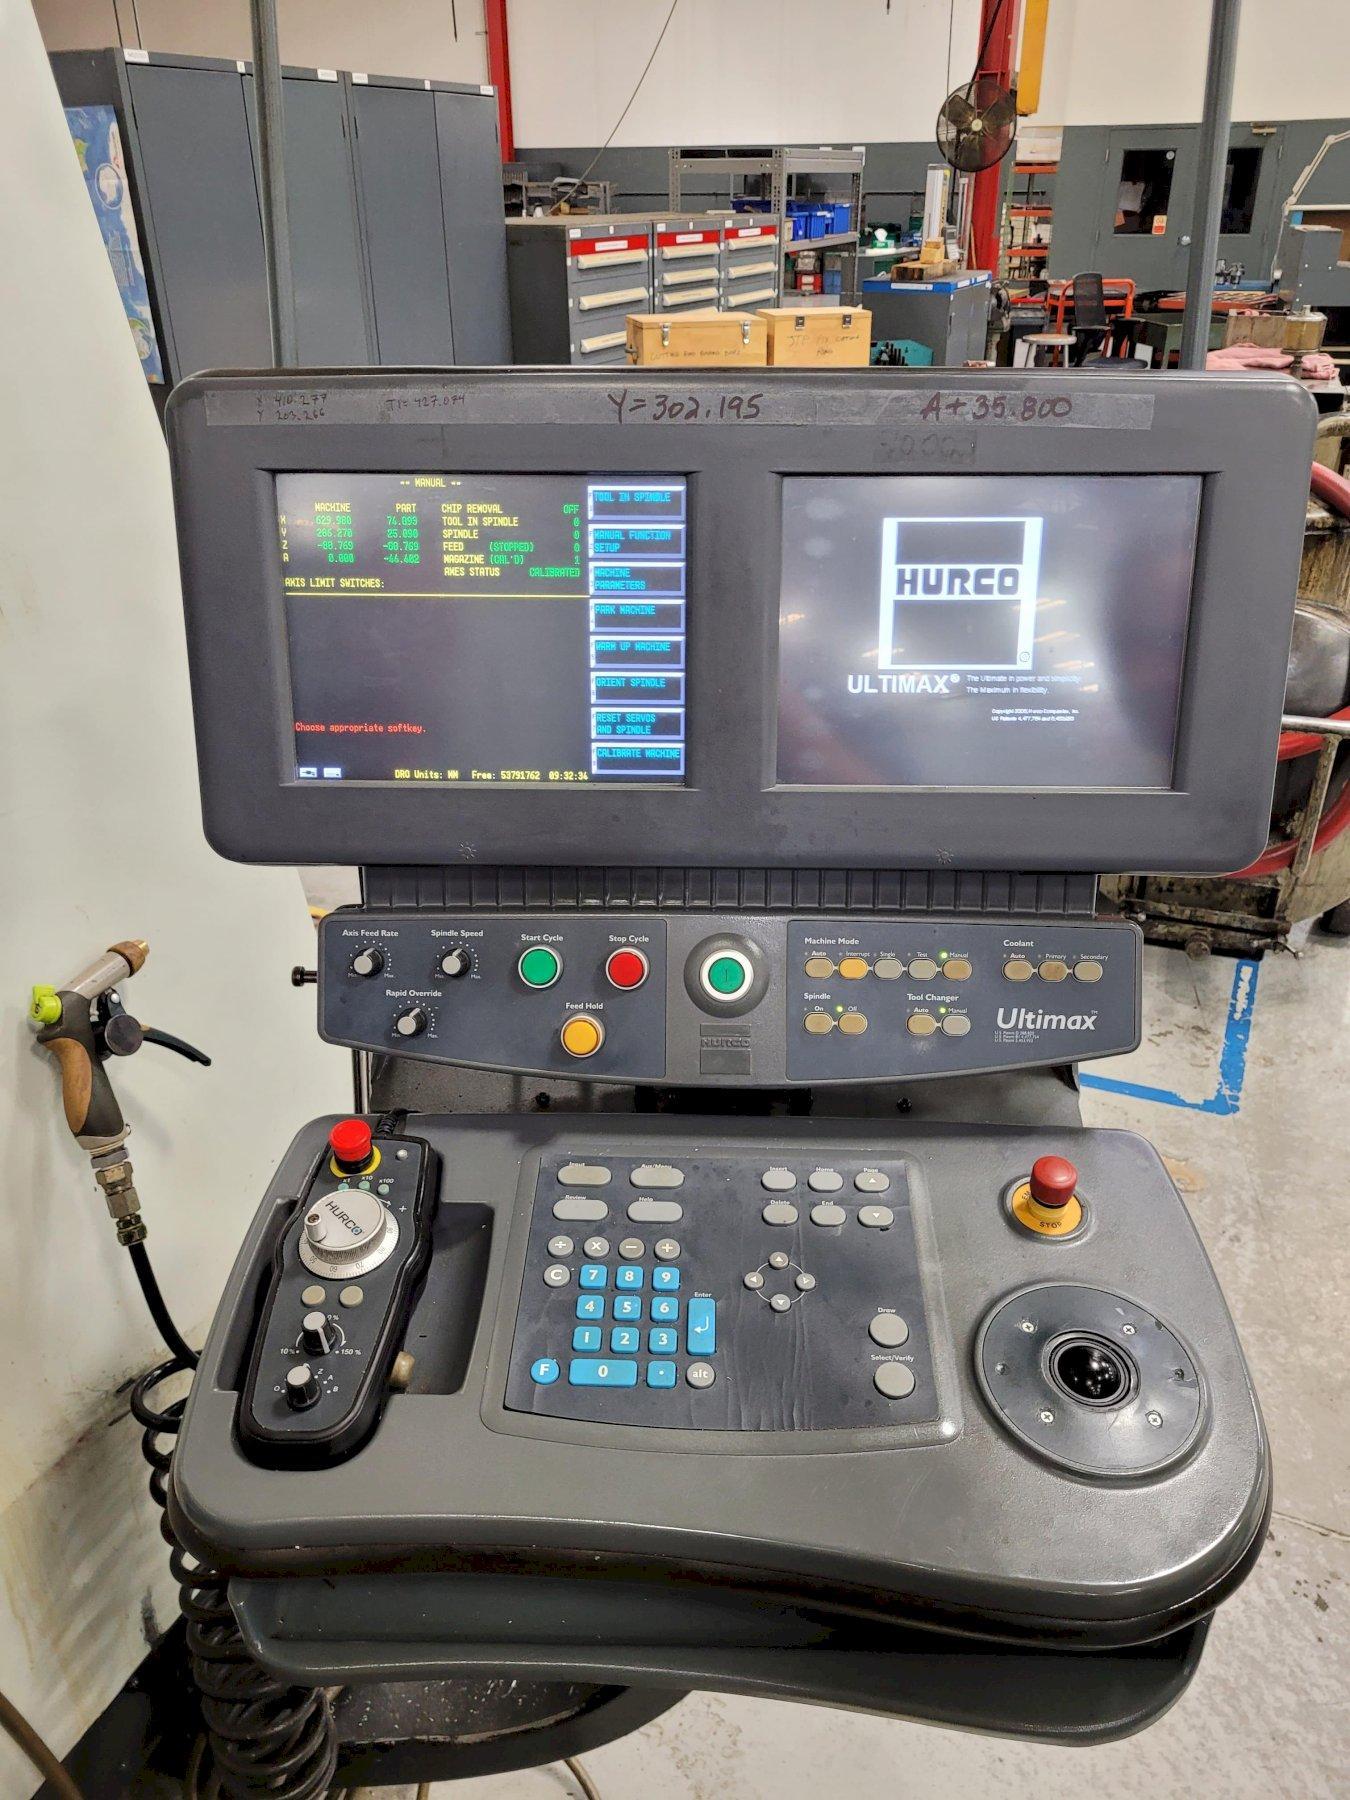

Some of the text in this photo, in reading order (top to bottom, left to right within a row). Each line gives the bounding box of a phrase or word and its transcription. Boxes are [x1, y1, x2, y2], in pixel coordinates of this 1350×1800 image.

[607, 389, 763, 424] Y=302.195
[920, 392, 1072, 421] A+35.800
[415, 478, 446, 488] MANUAL
[594, 492, 671, 502] TOOL IN SPINDLE
[315, 503, 351, 513] MACHINE
[396, 503, 417, 513] PART
[441, 504, 503, 514] CHIP REMOVAL
[563, 504, 580, 514] OFF
[442, 517, 519, 527] TOOL IN SPINDLE
[443, 530, 479, 539] SPINDLE
[594, 530, 671, 540] MANUAL FUNCTION
[281, 541, 288, 550] Z
[443, 542, 534, 552] FEED (STOPPED)
[594, 543, 621, 552] SETUP
[443, 555, 485, 564] MAGAZINE
[444, 567, 500, 577] AXES STATUS
[529, 567, 580, 577] CALIBRATED
[594, 568, 631, 578] MACHINE
[285, 578, 385, 589] AXIS LIMIT SWITCHES:
[594, 580, 646, 590] PARAMETERS
[896, 568, 1019, 595] HURCO
[594, 605, 656, 615] PARK MACHINE
[595, 642, 671, 651] WARM UP MACHINE
[596, 678, 666, 688] ORIENT SPINDLE
[597, 714, 656, 723] RESET SERVOS
[295, 722, 427, 735] Choose appropriate softkey.
[597, 726, 652, 735] AND SPINDLE
[597, 748, 680, 759] CALIBRATE MACHINE
[394, 769, 410, 779] DRO
[414, 769, 443, 780] Units:
[471, 770, 496, 780] Free:
[342, 929, 359, 937] Axis
[361, 929, 379, 937] Feed
[431, 929, 484, 938] Spindle Speed
[542, 934, 564, 943] Cycle
[609, 935, 650, 944] Stop Cycle
[804, 937, 836, 945] Machine
[1003, 939, 1034, 947] Coolant
[880, 951, 896, 959] Single
[385, 989, 442, 998] Rapid Override
[804, 993, 831, 1002] Spindle
[907, 993, 960, 1003] Tool Changer
[565, 1002, 604, 1010] Feed Hold
[996, 1007, 1098, 1031] Ultimax
[325, 1200, 363, 1236] HURCO
[1039, 1221, 1062, 1229] STOP
[550, 1270, 562, 1280] C
[588, 1270, 598, 1280] 7
[624, 1271, 634, 1281] 8
[661, 1272, 671, 1283] 9
[584, 1301, 595, 1312] 4
[622, 1302, 632, 1313] 5
[659, 1303, 670, 1314] 6
[620, 1332, 630, 1345] 2
[658, 1333, 668, 1345] 3
[870, 1354, 915, 1362] Select/Verify
[539, 1364, 550, 1376] F
[597, 1365, 609, 1378] 0
[692, 1369, 709, 1378] alt
